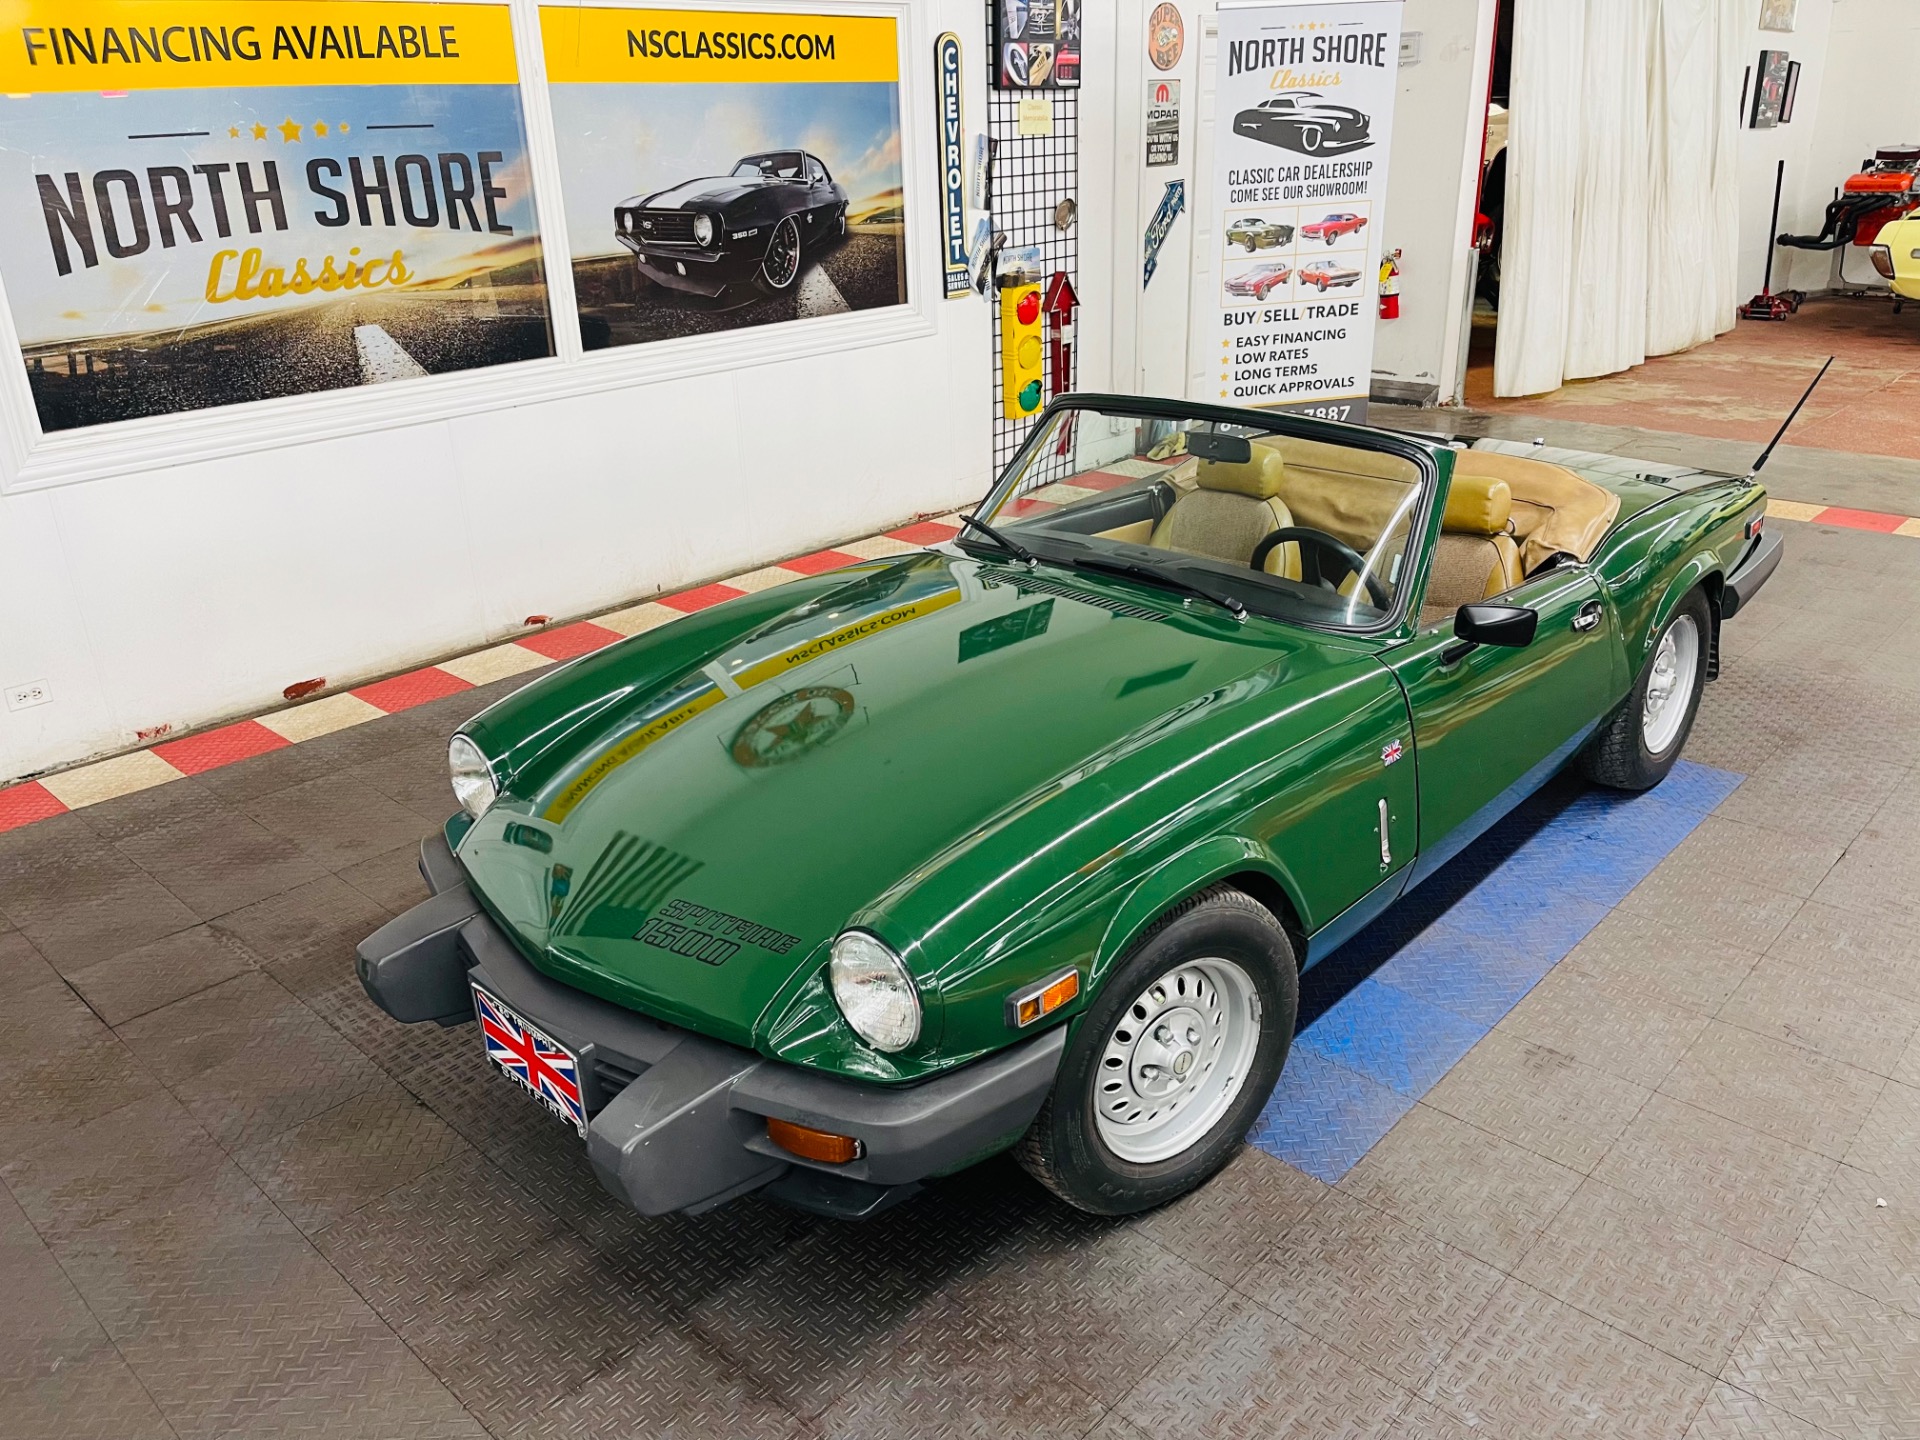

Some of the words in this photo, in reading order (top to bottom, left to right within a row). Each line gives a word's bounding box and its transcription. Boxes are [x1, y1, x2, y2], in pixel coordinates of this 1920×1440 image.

[22, 26, 261, 66] FINANCING
[272, 25, 461, 60] AVAILABLE
[627, 29, 836, 60] NSCLASSICS.COM
[1156, 43, 1178, 67] BEE
[1228, 37, 1305, 77] NORTH
[1312, 32, 1388, 68] SHORE
[1269, 69, 1343, 90] Classics
[1147, 110, 1179, 119] MOPAR
[944, 46, 963, 260] CHEVROLET
[1228, 167, 1275, 186] CLASSIC
[1278, 165, 1300, 182] CAR
[1304, 161, 1373, 180] DEALERSHIP
[1230, 187, 1259, 203] COME
[1262, 186, 1280, 201] SEE
[1283, 184, 1303, 200] OUR
[1305, 180, 1368, 198] SHOWROOM!
[36, 159, 288, 278] NORTH
[306, 151, 514, 237] SHORE
[1151, 203, 1174, 249] Ford
[205, 246, 417, 305] Classics
[946, 272, 964, 282] SALES
[946, 280, 969, 291] SERVICE
[1223, 303, 1360, 326] BUY/SELL/TRADE
[1236, 334, 1270, 348] EASY
[1272, 328, 1347, 346] FINANCING
[1235, 351, 1267, 365] LOW
[1269, 348, 1309, 362] RATES
[1234, 367, 1272, 382] LONG
[1274, 363, 1318, 378] TERMS
[1233, 384, 1276, 398] QUICK
[1278, 376, 1355, 394] APPROVALS
[659, 899, 802, 955] SPITFIRE
[631, 917, 742, 967] 1500
[501, 1065, 569, 1126] SPITFIRE
